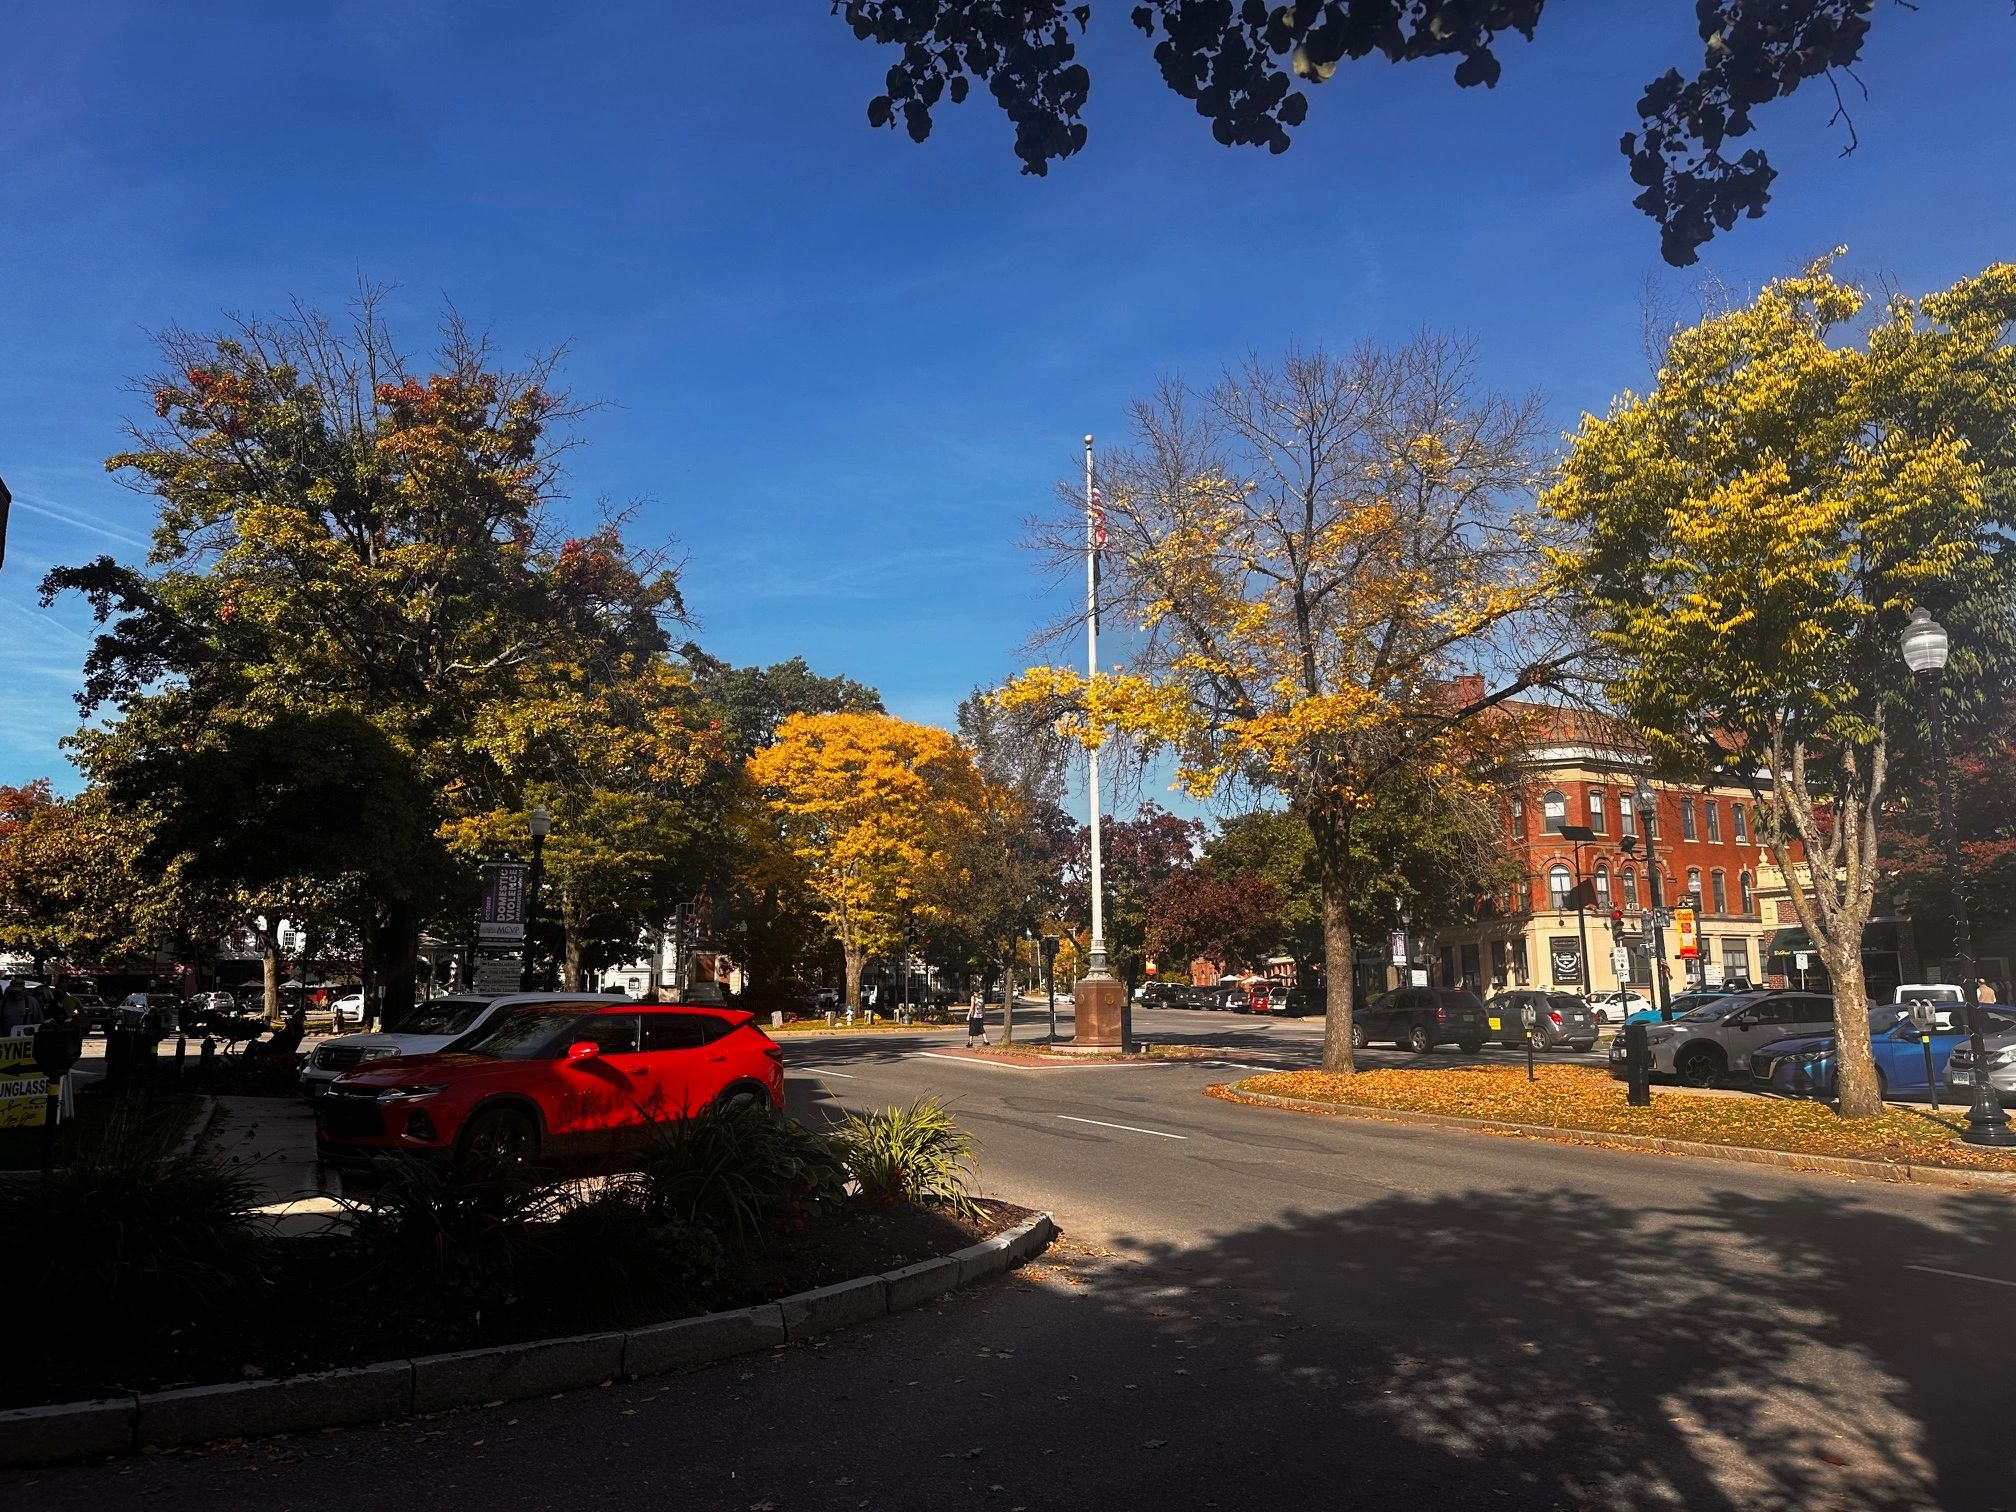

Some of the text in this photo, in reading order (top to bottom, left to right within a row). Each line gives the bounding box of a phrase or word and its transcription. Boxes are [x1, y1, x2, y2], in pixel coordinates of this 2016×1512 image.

[497, 868, 509, 921] DOMESTIC
[506, 869, 518, 921] VIOLENCE
[497, 926, 520, 934] MCVP
